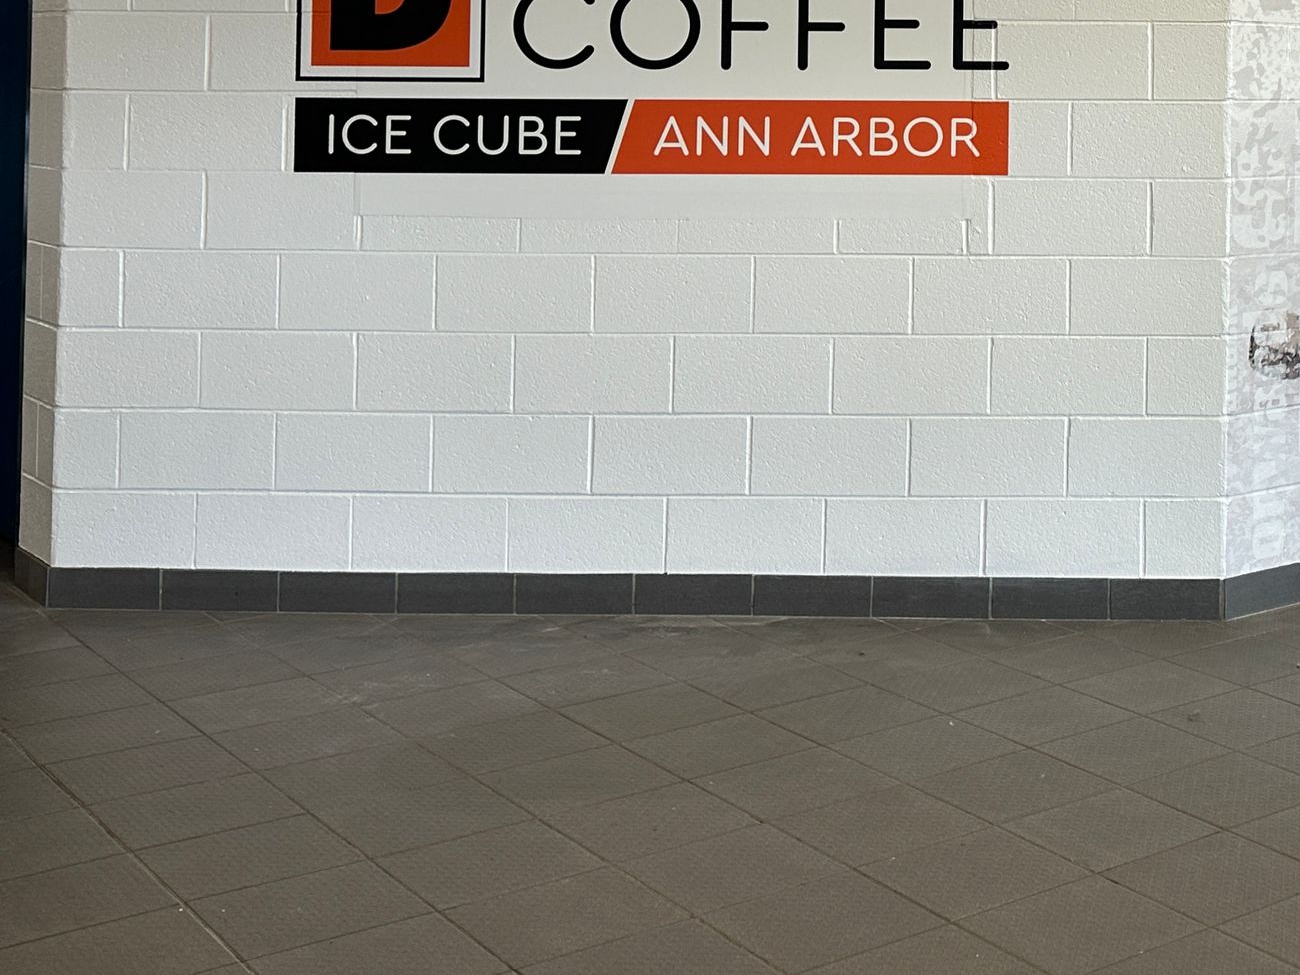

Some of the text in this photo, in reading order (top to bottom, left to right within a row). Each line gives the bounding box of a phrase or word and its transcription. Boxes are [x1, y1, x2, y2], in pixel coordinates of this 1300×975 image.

[328, 114, 582, 156] ICE CUBE
[653, 115, 980, 158] ANN ARBOR
